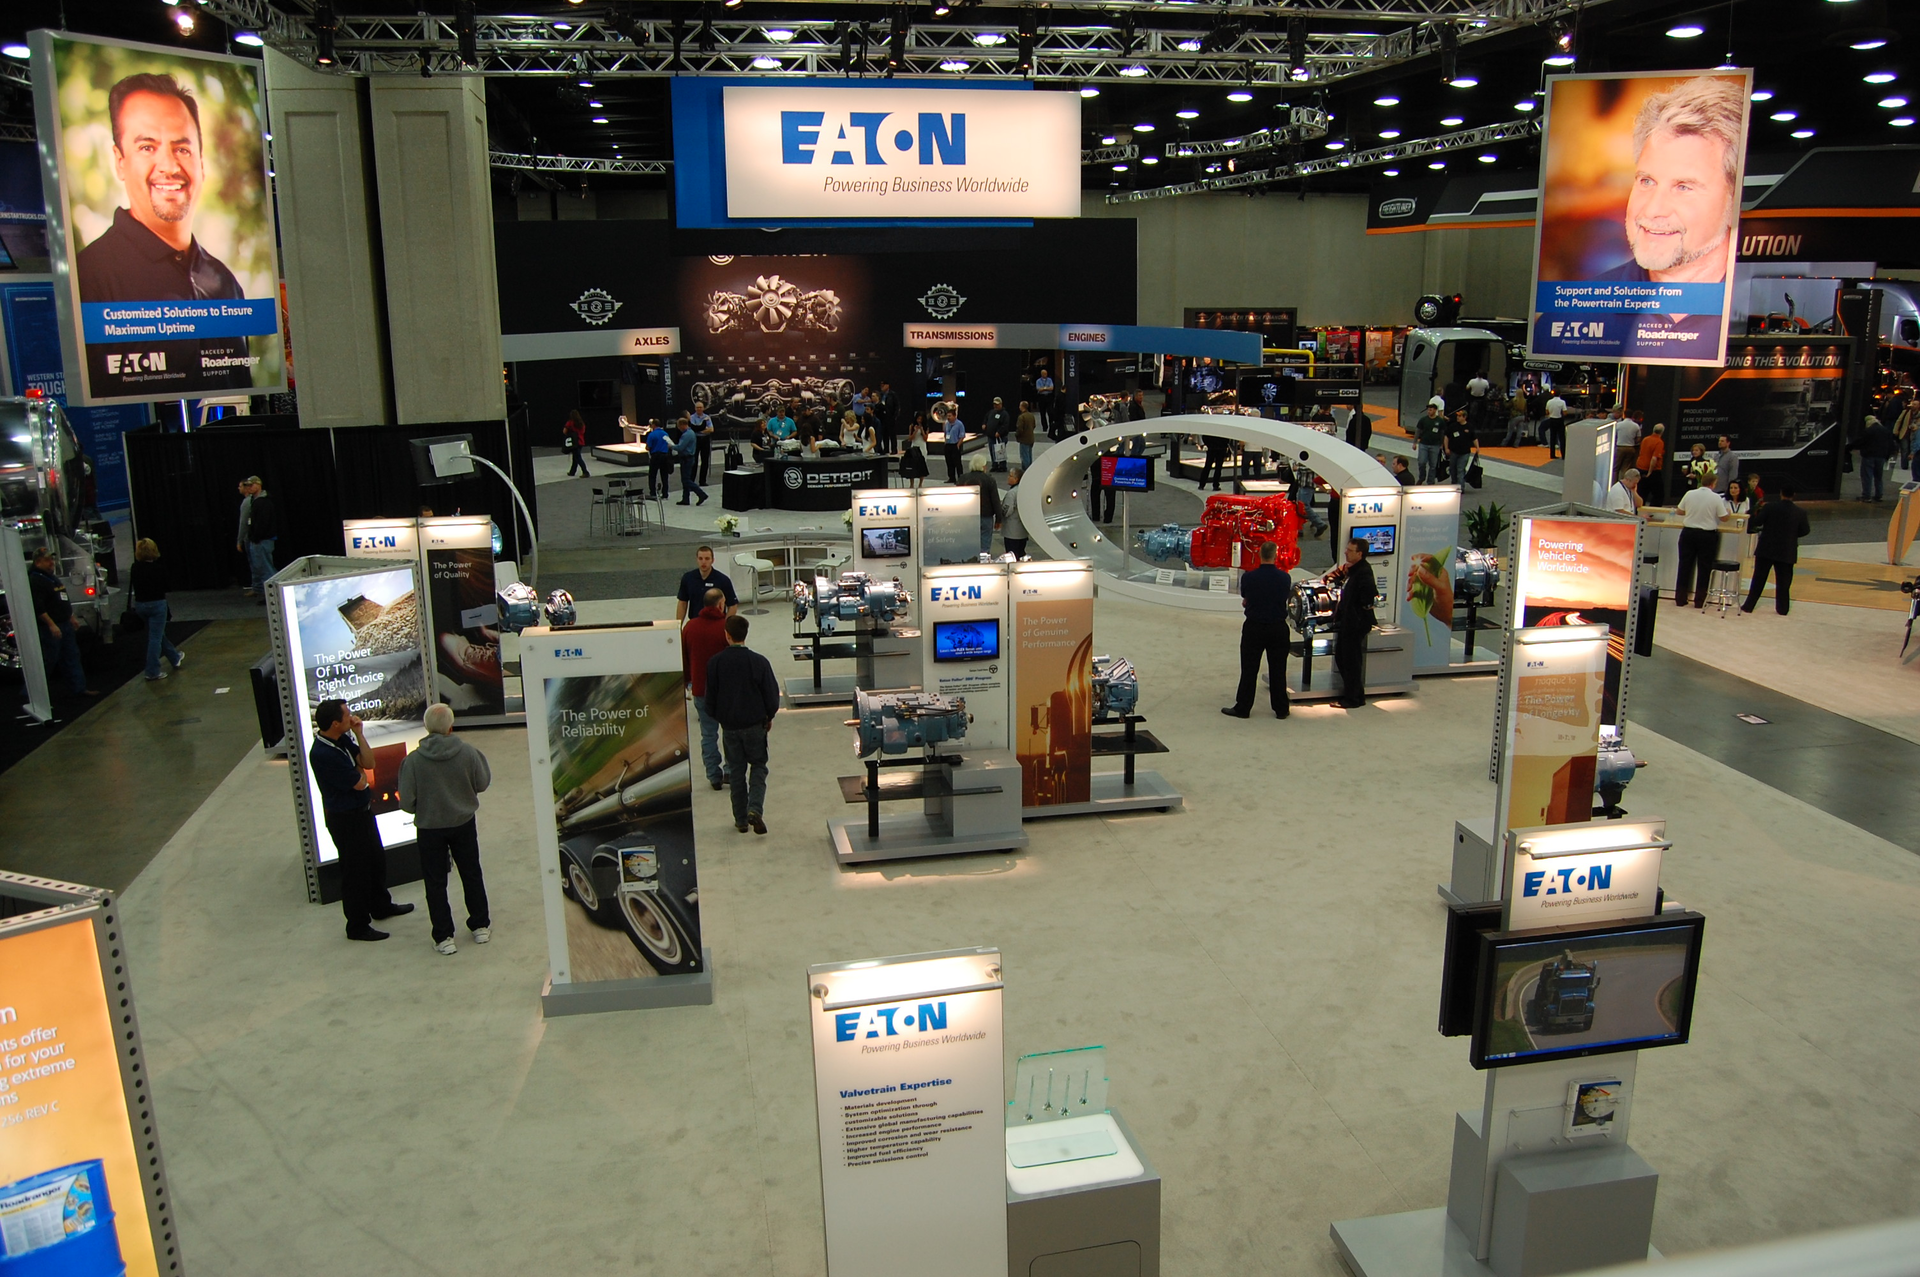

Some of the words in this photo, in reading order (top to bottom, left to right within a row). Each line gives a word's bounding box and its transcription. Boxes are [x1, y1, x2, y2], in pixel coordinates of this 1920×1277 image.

[780, 110, 966, 166] EATON
[824, 176, 888, 196] Powering
[892, 177, 953, 193] Business
[957, 177, 1029, 193] Worldwide
[1555, 286, 1593, 297] Support
[1594, 286, 1612, 296] and
[1613, 286, 1657, 297] Solutions
[1659, 286, 1683, 297] from
[1555, 299, 1570, 308] the
[1571, 299, 1622, 309] Powertrain
[1624, 300, 1661, 310] Experts
[103, 308, 162, 320] Customized
[163, 307, 209, 318] Solutions
[209, 307, 220, 316] to
[221, 305, 253, 316] Ensure
[104, 324, 157, 336] Maximum
[158, 323, 196, 336] Uptime
[910, 331, 994, 341] TRANSMISSIONS
[1551, 322, 1604, 338] EATON
[1637, 329, 1699, 342] Roadranger
[634, 336, 670, 346] AXLES
[1068, 333, 1106, 342] ENGINES
[106, 352, 167, 375] EATON
[201, 355, 260, 368] Roadranger
[1754, 356, 1776, 367] THE
[1777, 356, 1840, 367] EVOLUTION
[27, 372, 55, 381] WESTERN
[56, 372, 65, 380] ST
[664, 357, 672, 385] STEER
[807, 470, 873, 483] DETROIT
[859, 505, 897, 516] EATON
[1348, 503, 1383, 514] EATON
[353, 536, 396, 549] EATON
[1538, 538, 1584, 552] Powering
[1538, 551, 1577, 562] Vehicles
[448, 561, 472, 569] Power
[1537, 562, 1589, 573] Worldwide
[443, 571, 470, 579] Quality
[931, 585, 981, 601] EATON
[1023, 617, 1038, 626] The
[1040, 616, 1067, 625] Power
[1023, 629, 1032, 637] of
[1033, 628, 1069, 637] Genuine
[1022, 639, 1076, 648] Performance
[314, 654, 336, 665] The
[338, 648, 372, 662] Power
[554, 648, 582, 657] EATON
[315, 666, 331, 678] Of
[333, 663, 356, 675] The
[317, 678, 346, 692] Right
[348, 671, 384, 686] Choice
[338, 689, 362, 700] Your
[1524, 695, 1541, 705] The
[1544, 694, 1575, 702] Power
[347, 697, 382, 712] ication
[560, 709, 586, 722] The
[591, 707, 632, 720] Power
[635, 705, 649, 717] of
[1535, 709, 1580, 719] Longevity
[562, 723, 626, 738] Reliability
[1523, 864, 1612, 898] EATON
[1541, 900, 1572, 908] Powering
[1573, 896, 1602, 906] Business
[1603, 891, 1639, 902] Worldwide
[835, 1001, 948, 1043] EATON
[21, 1027, 58, 1047] offer
[861, 1042, 901, 1055] Powering
[902, 1038, 940, 1050] Business
[941, 1031, 986, 1044] Worldwide
[5, 1053, 27, 1069] for
[31, 1042, 66, 1064] your
[12, 1058, 76, 1085] extreme
[840, 1086, 897, 1099] Valvetrain
[900, 1078, 953, 1091] Expertise
[26, 1103, 49, 1120] REV
[51, 1100, 60, 1113] C
[844, 1103, 875, 1111] Materials
[876, 1097, 918, 1107] development
[870, 1105, 911, 1115] optimization
[912, 1101, 938, 1109] through
[845, 1115, 888, 1125] customizable
[889, 1111, 918, 1119] solutions
[845, 1124, 877, 1132] Extensive
[878, 1121, 898, 1129] global
[899, 1115, 946, 1125] manufacturing
[948, 1109, 984, 1119] capabilities
[846, 1131, 878, 1139] Increased
[878, 1128, 900, 1136] engine
[901, 1123, 942, 1133] performance
[846, 1138, 877, 1146] Improved
[878, 1134, 908, 1142] corrosion
[940, 1125, 972, 1133] resistance
[847, 1145, 868, 1154] Higher
[870, 1141, 909, 1151] temperature
[911, 1136, 941, 1145] capability
[847, 1152, 877, 1161] Improved
[893, 1146, 923, 1155] efficiency
[847, 1159, 871, 1167] Precise
[873, 1156, 904, 1164] emissions
